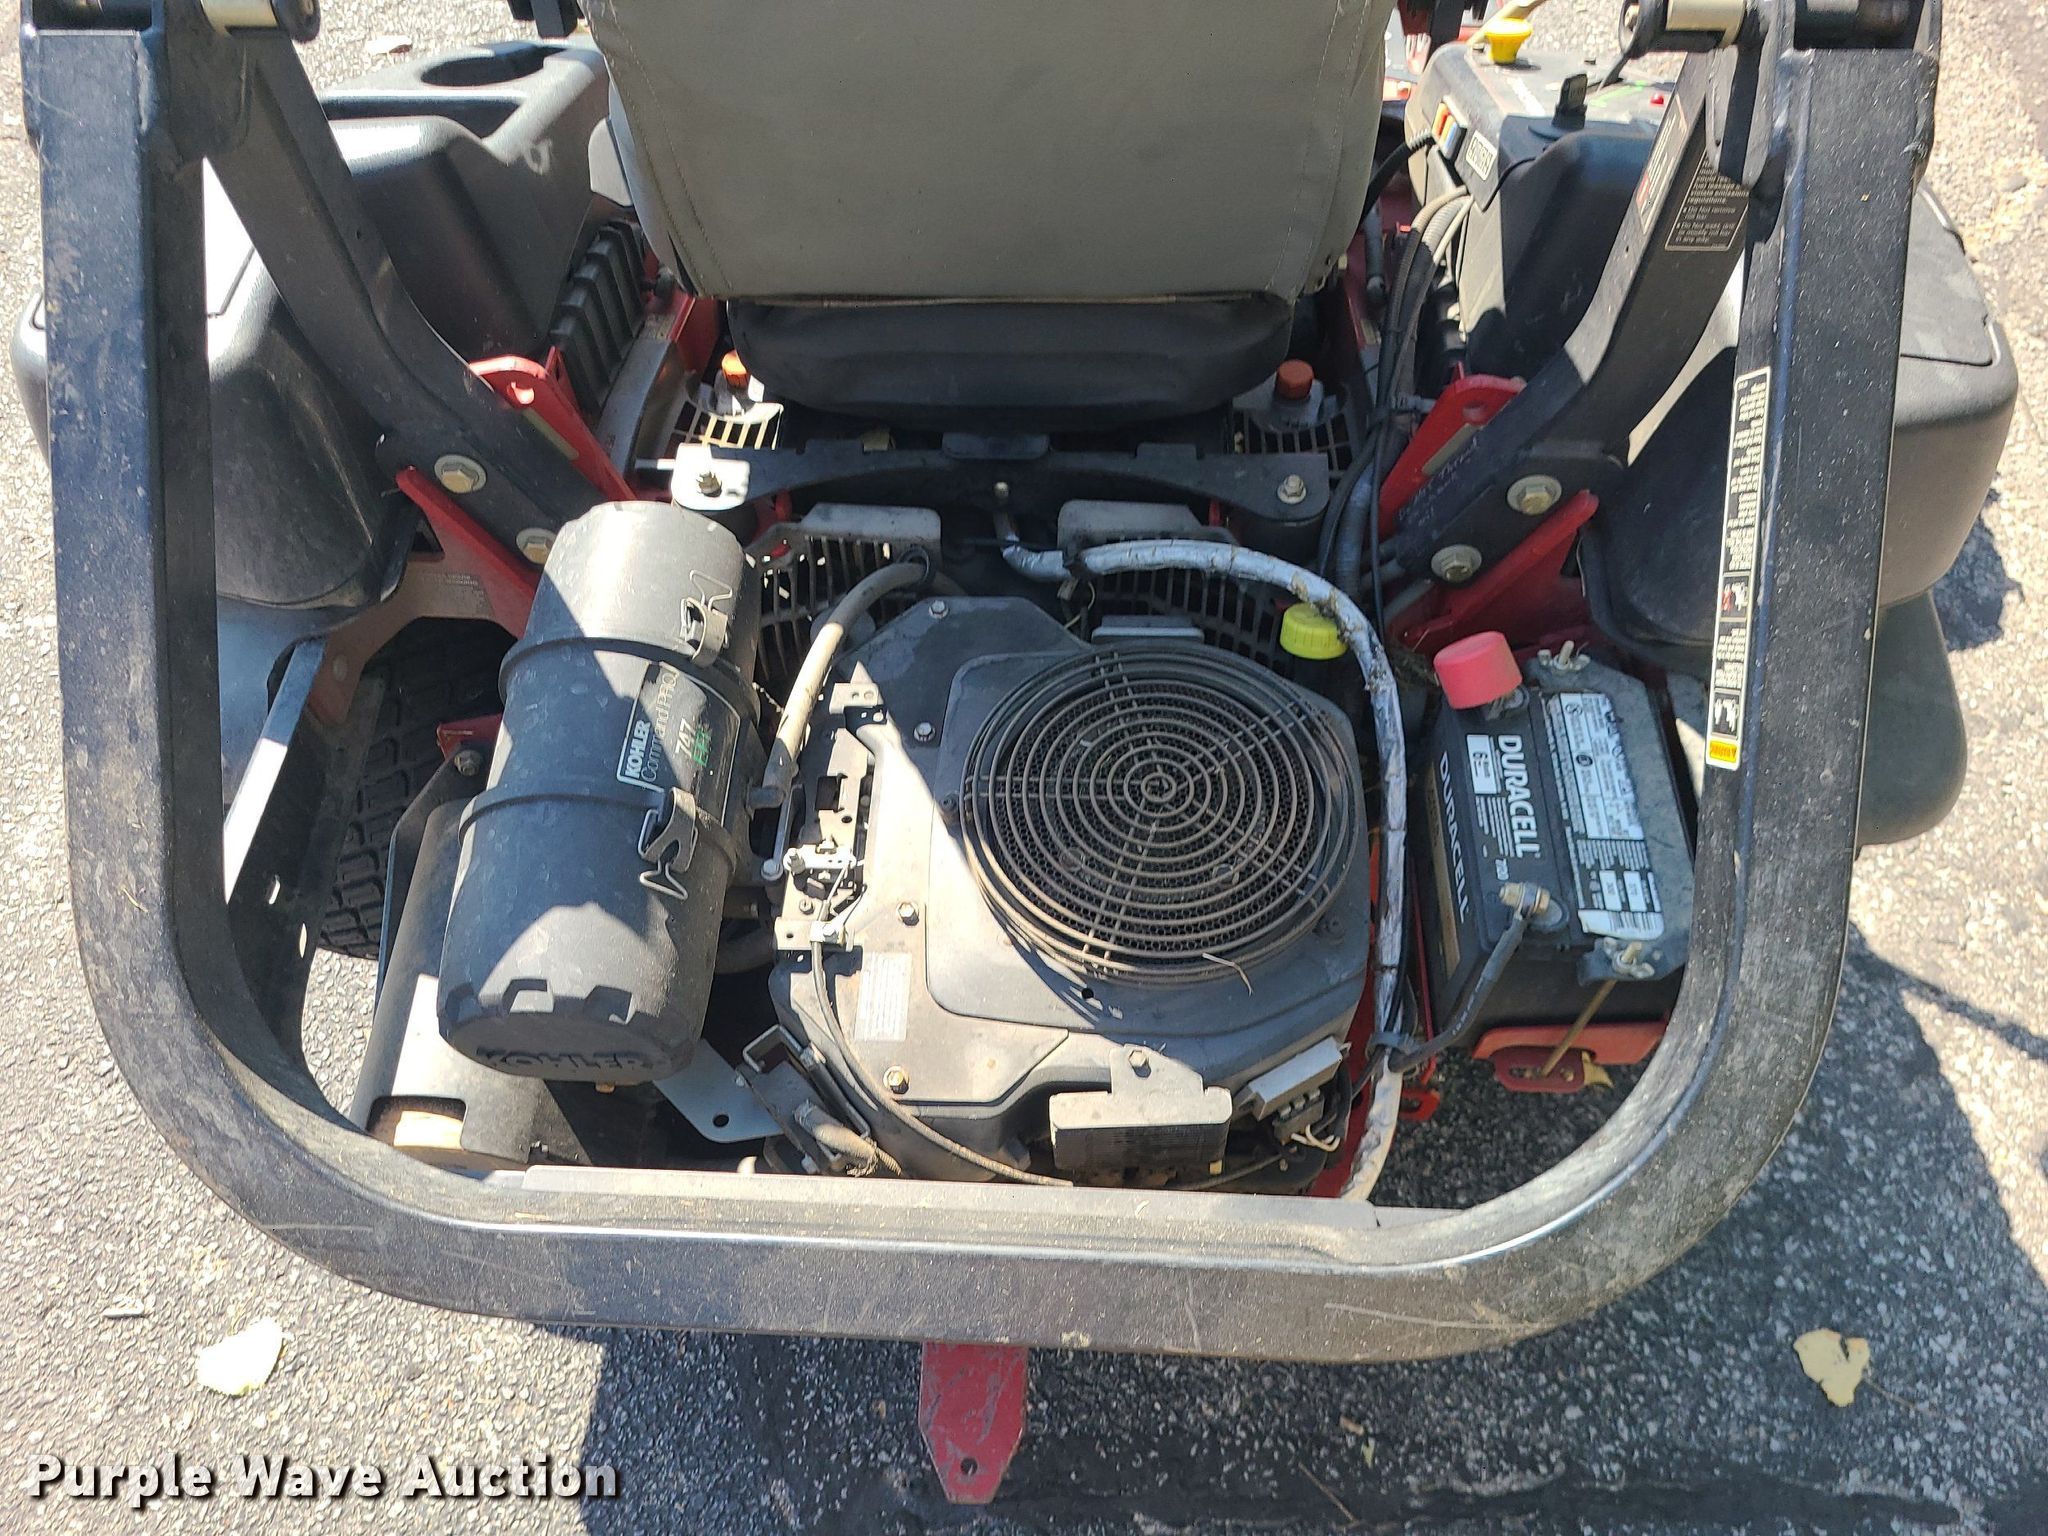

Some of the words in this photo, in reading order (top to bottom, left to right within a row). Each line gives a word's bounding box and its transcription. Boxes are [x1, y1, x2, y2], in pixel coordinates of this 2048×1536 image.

[624, 719, 652, 779] KOHLER
[640, 706, 670, 782] Command
[656, 672, 677, 707] PRO
[675, 717, 697, 758] 747
[1439, 751, 1469, 924] DURACELL
[1498, 734, 1541, 859] DURACELL
